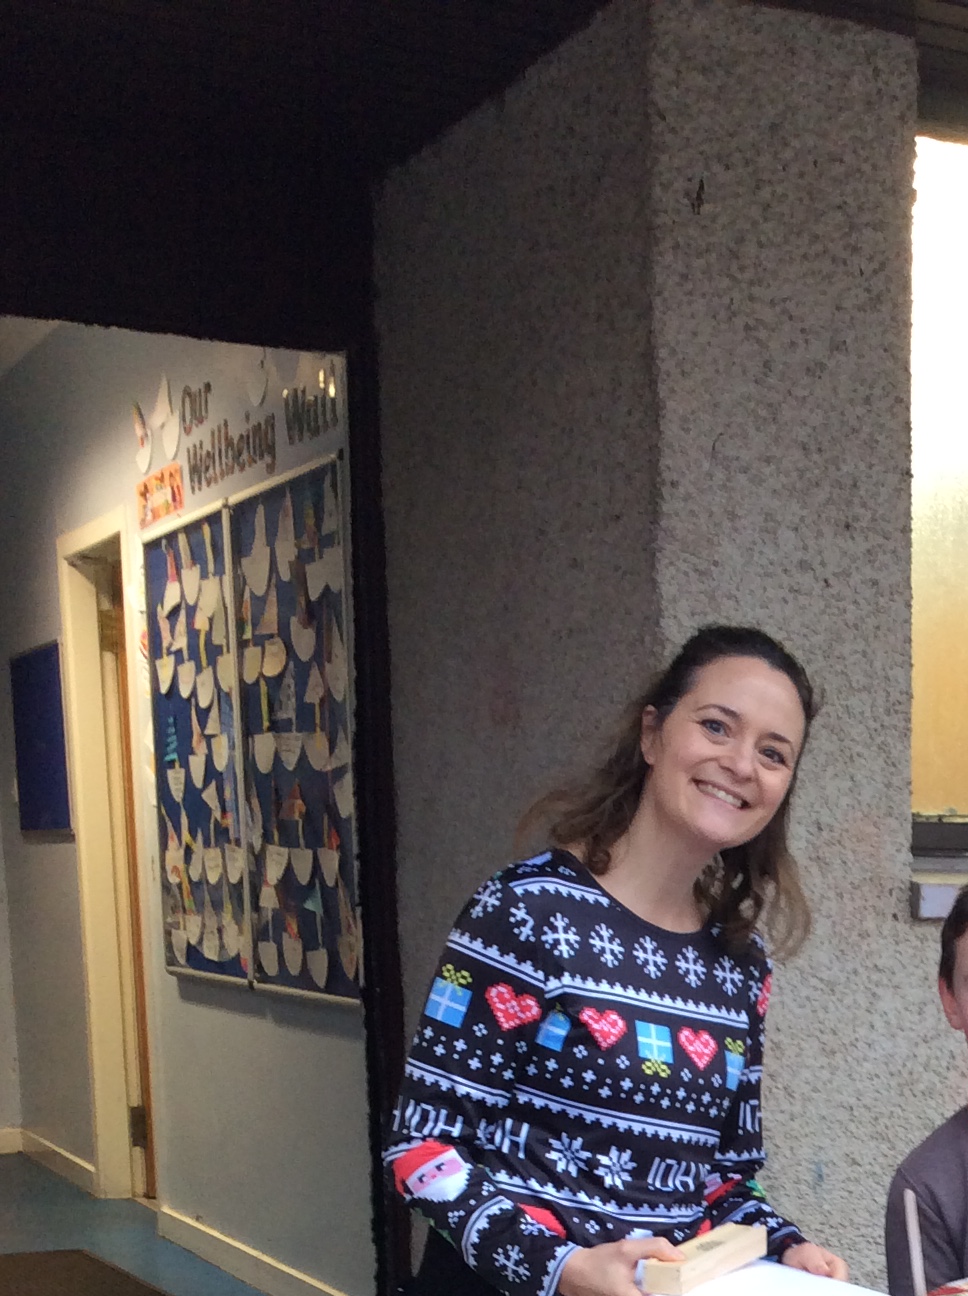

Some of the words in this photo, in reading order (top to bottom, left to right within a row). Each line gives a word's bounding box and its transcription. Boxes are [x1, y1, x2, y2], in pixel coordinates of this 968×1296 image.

[181, 381, 212, 436] Our
[187, 412, 276, 495] Wellbeing
[283, 358, 338, 446] Wall
